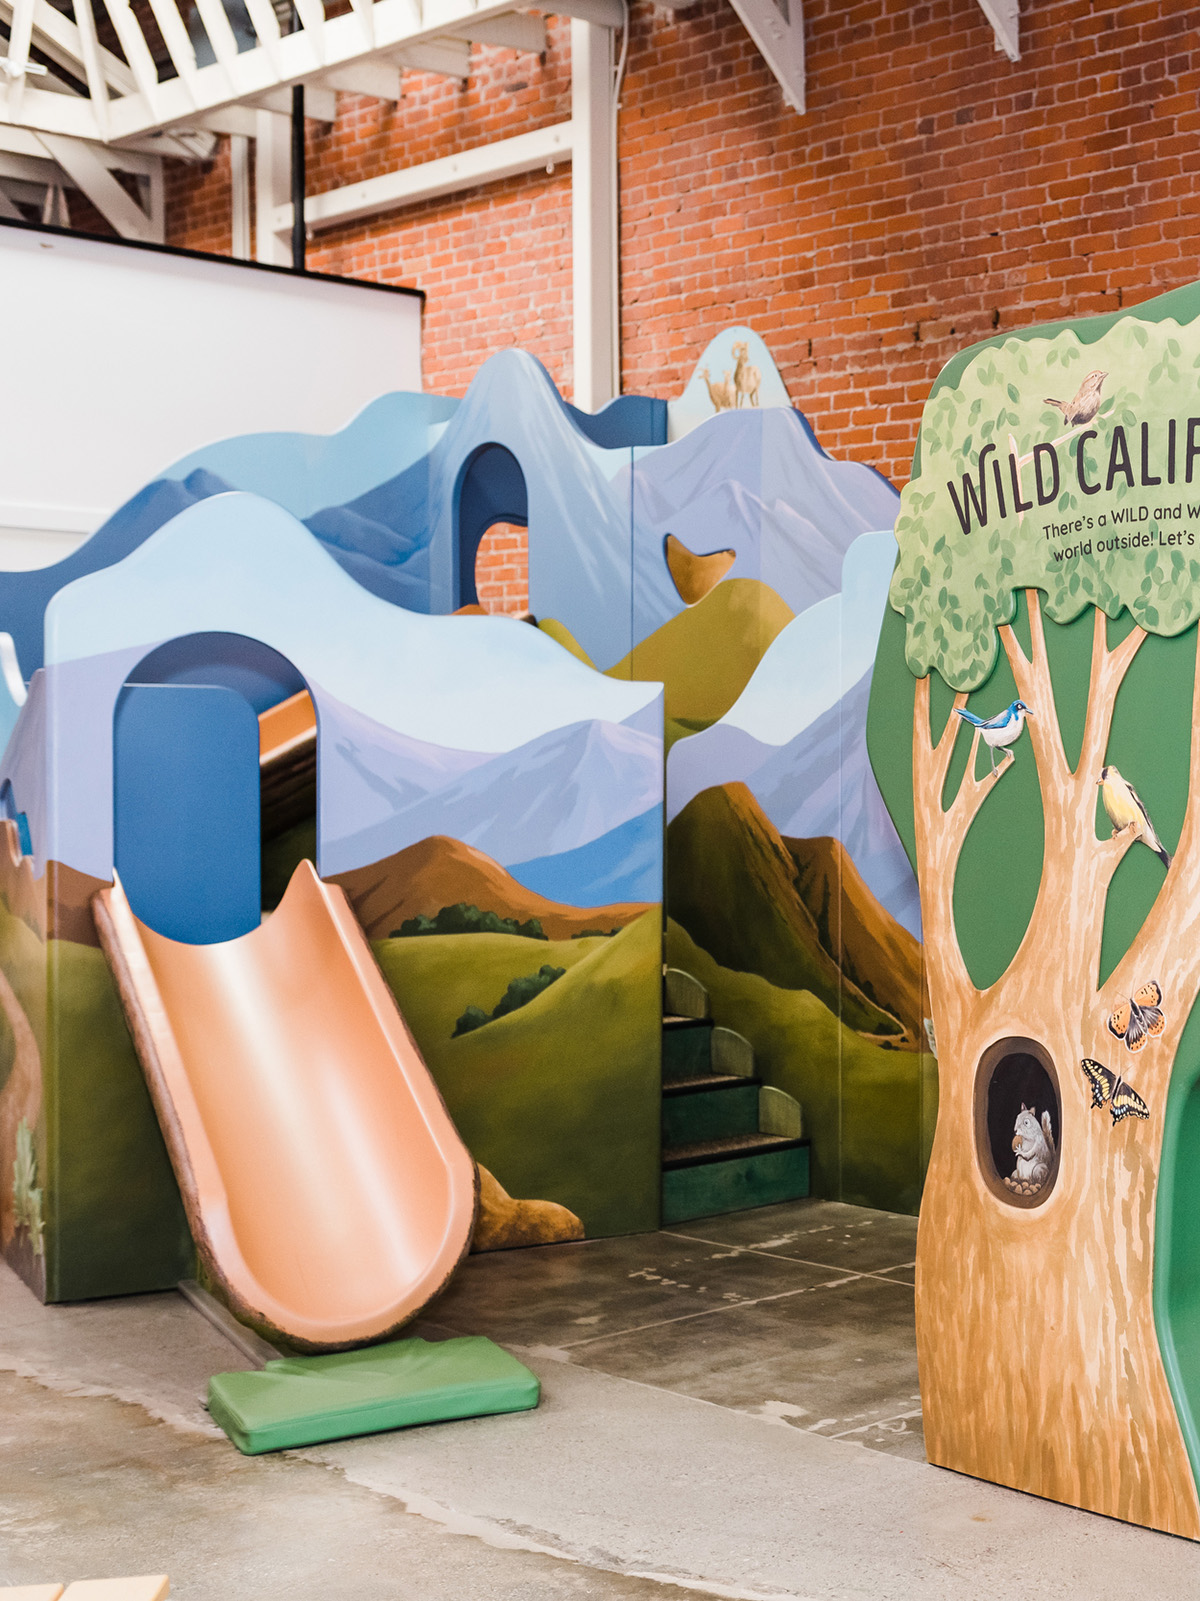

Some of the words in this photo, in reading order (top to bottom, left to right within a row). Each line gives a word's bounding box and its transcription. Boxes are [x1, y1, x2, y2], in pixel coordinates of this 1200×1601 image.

[946, 443, 1061, 536] WILD
[1042, 515, 1093, 540] There's
[1098, 514, 1107, 526] a
[1111, 506, 1149, 524] WILD
[1154, 503, 1182, 520] and
[1053, 539, 1092, 562] world
[1096, 531, 1154, 552] outside!
[1158, 530, 1195, 546] Let's
